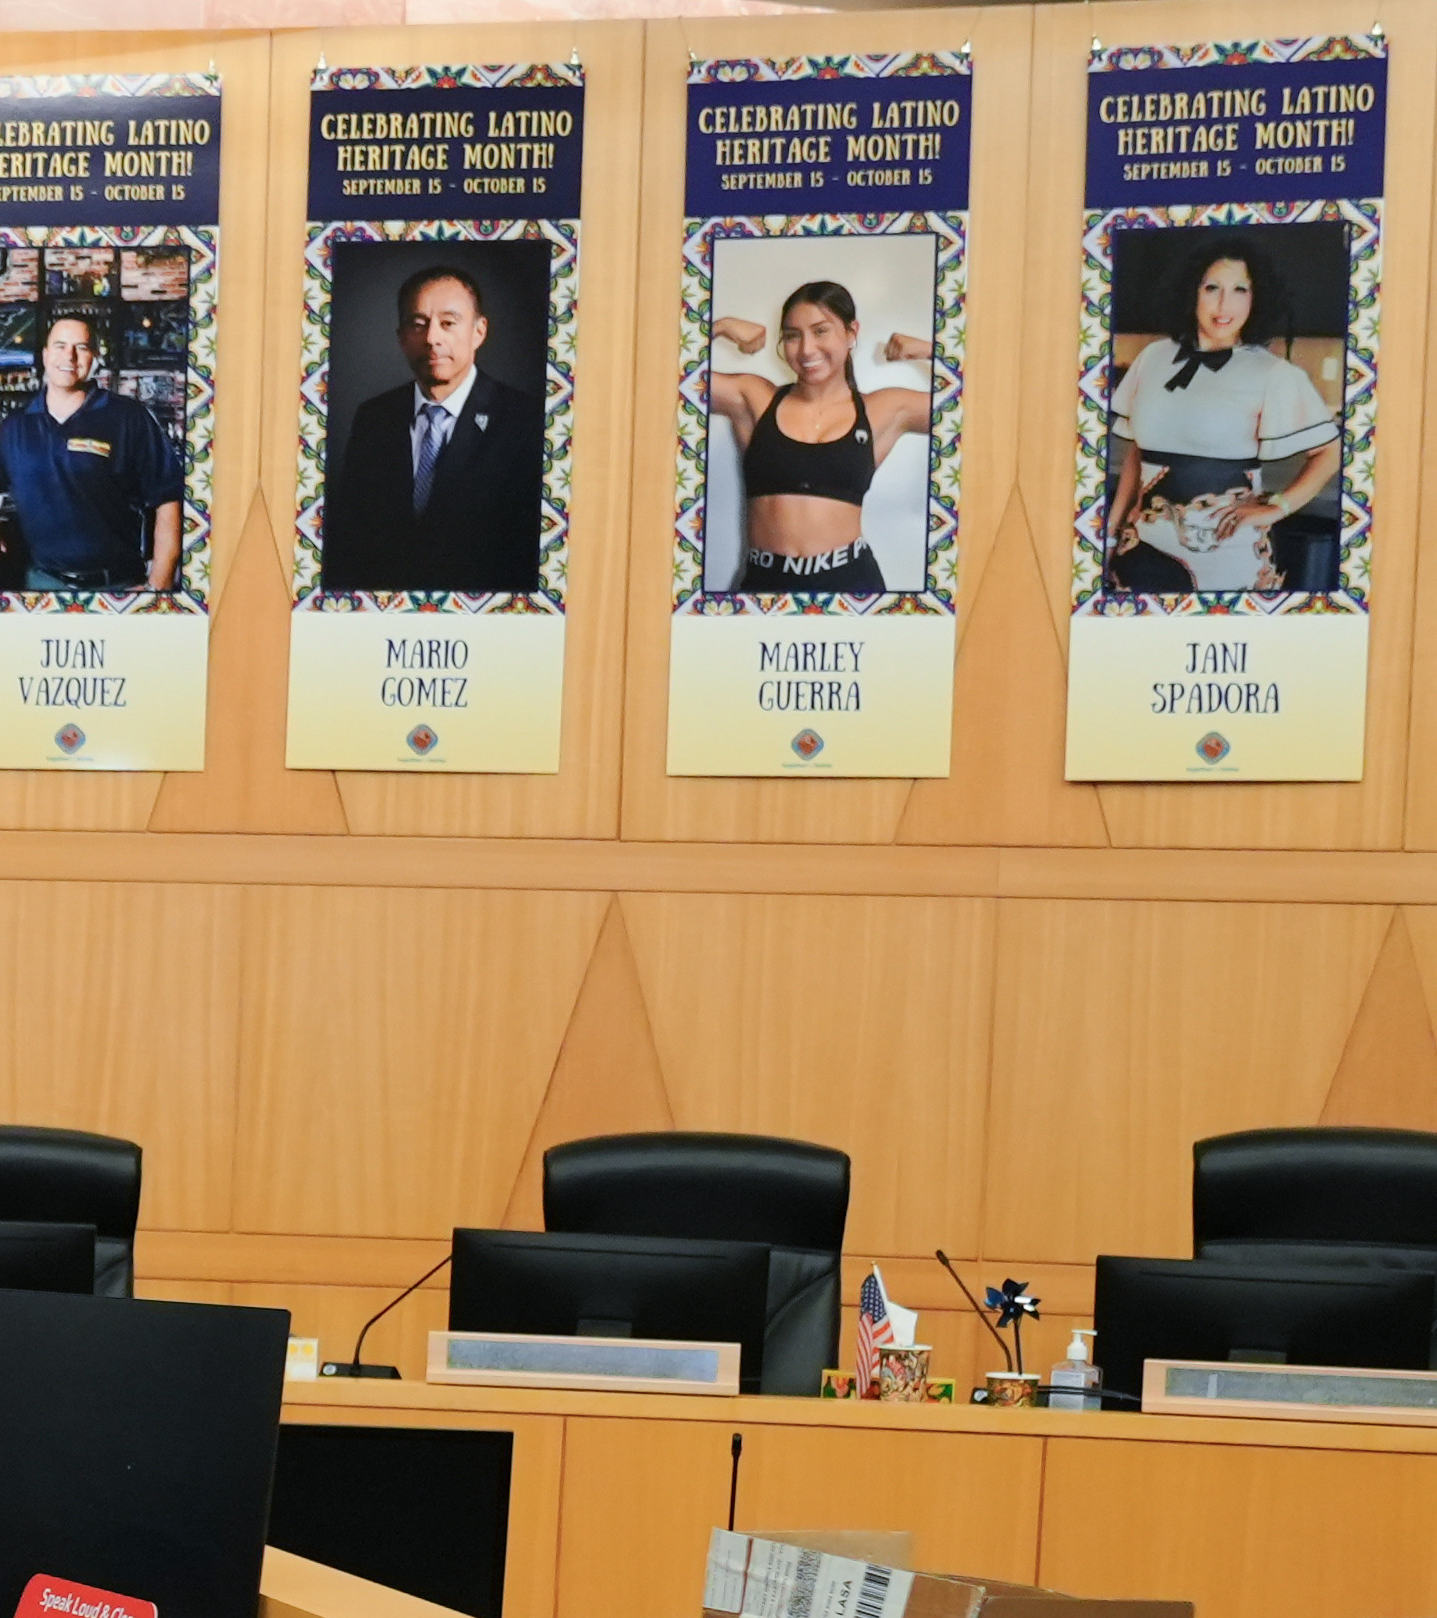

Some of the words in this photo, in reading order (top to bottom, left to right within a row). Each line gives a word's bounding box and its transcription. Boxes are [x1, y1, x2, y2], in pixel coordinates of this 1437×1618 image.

[699, 102, 858, 134] CELEBRATING
[871, 100, 960, 129] LATINO
[1099, 88, 1267, 124] CELEBRATING
[1281, 83, 1375, 116] LATINO
[127, 119, 211, 146] LATINO
[321, 111, 475, 140] CELEBRATING
[487, 110, 573, 138] LATINO
[1117, 122, 1239, 156] HERITAGE
[1255, 118, 1355, 150] MONTH!
[104, 150, 193, 177] MONTH!
[337, 143, 449, 171] HERITAGE
[463, 142, 555, 170] MONTH!
[715, 136, 832, 166] HERITAGE
[846, 133, 941, 162] MONTH!
[721, 172, 803, 190] SEPTEMBER
[810, 171, 824, 188] 15
[847, 169, 911, 187] OCTOBER
[918, 167, 932, 185] 15
[1123, 160, 1209, 181] SEPTEMBER
[1217, 159, 1231, 176] 15
[1255, 156, 1323, 176] OCTOBER
[1331, 155, 1346, 173] 15
[70, 185, 84, 201] 15
[105, 184, 165, 201] OCTOBER
[172, 184, 185, 200] 15
[342, 178, 421, 196] SEPTEMBER
[429, 178, 442, 194] 15
[463, 177, 525, 194] OCTOBER
[533, 176, 546, 193] 15
[783, 545, 849, 575] NIKE
[40, 639, 106, 669] JUAN
[385, 638, 470, 670] MARIO
[759, 642, 865, 673] MARLEY
[1185, 642, 1248, 674] JANI
[18, 676, 127, 709] VAZQUEZ
[381, 677, 468, 708] GOMEZ
[759, 680, 862, 712] GUERRA
[1151, 682, 1280, 714] SPADORA
[39, 1588, 73, 1612] Speak
[836, 1580, 853, 1615] LASA
